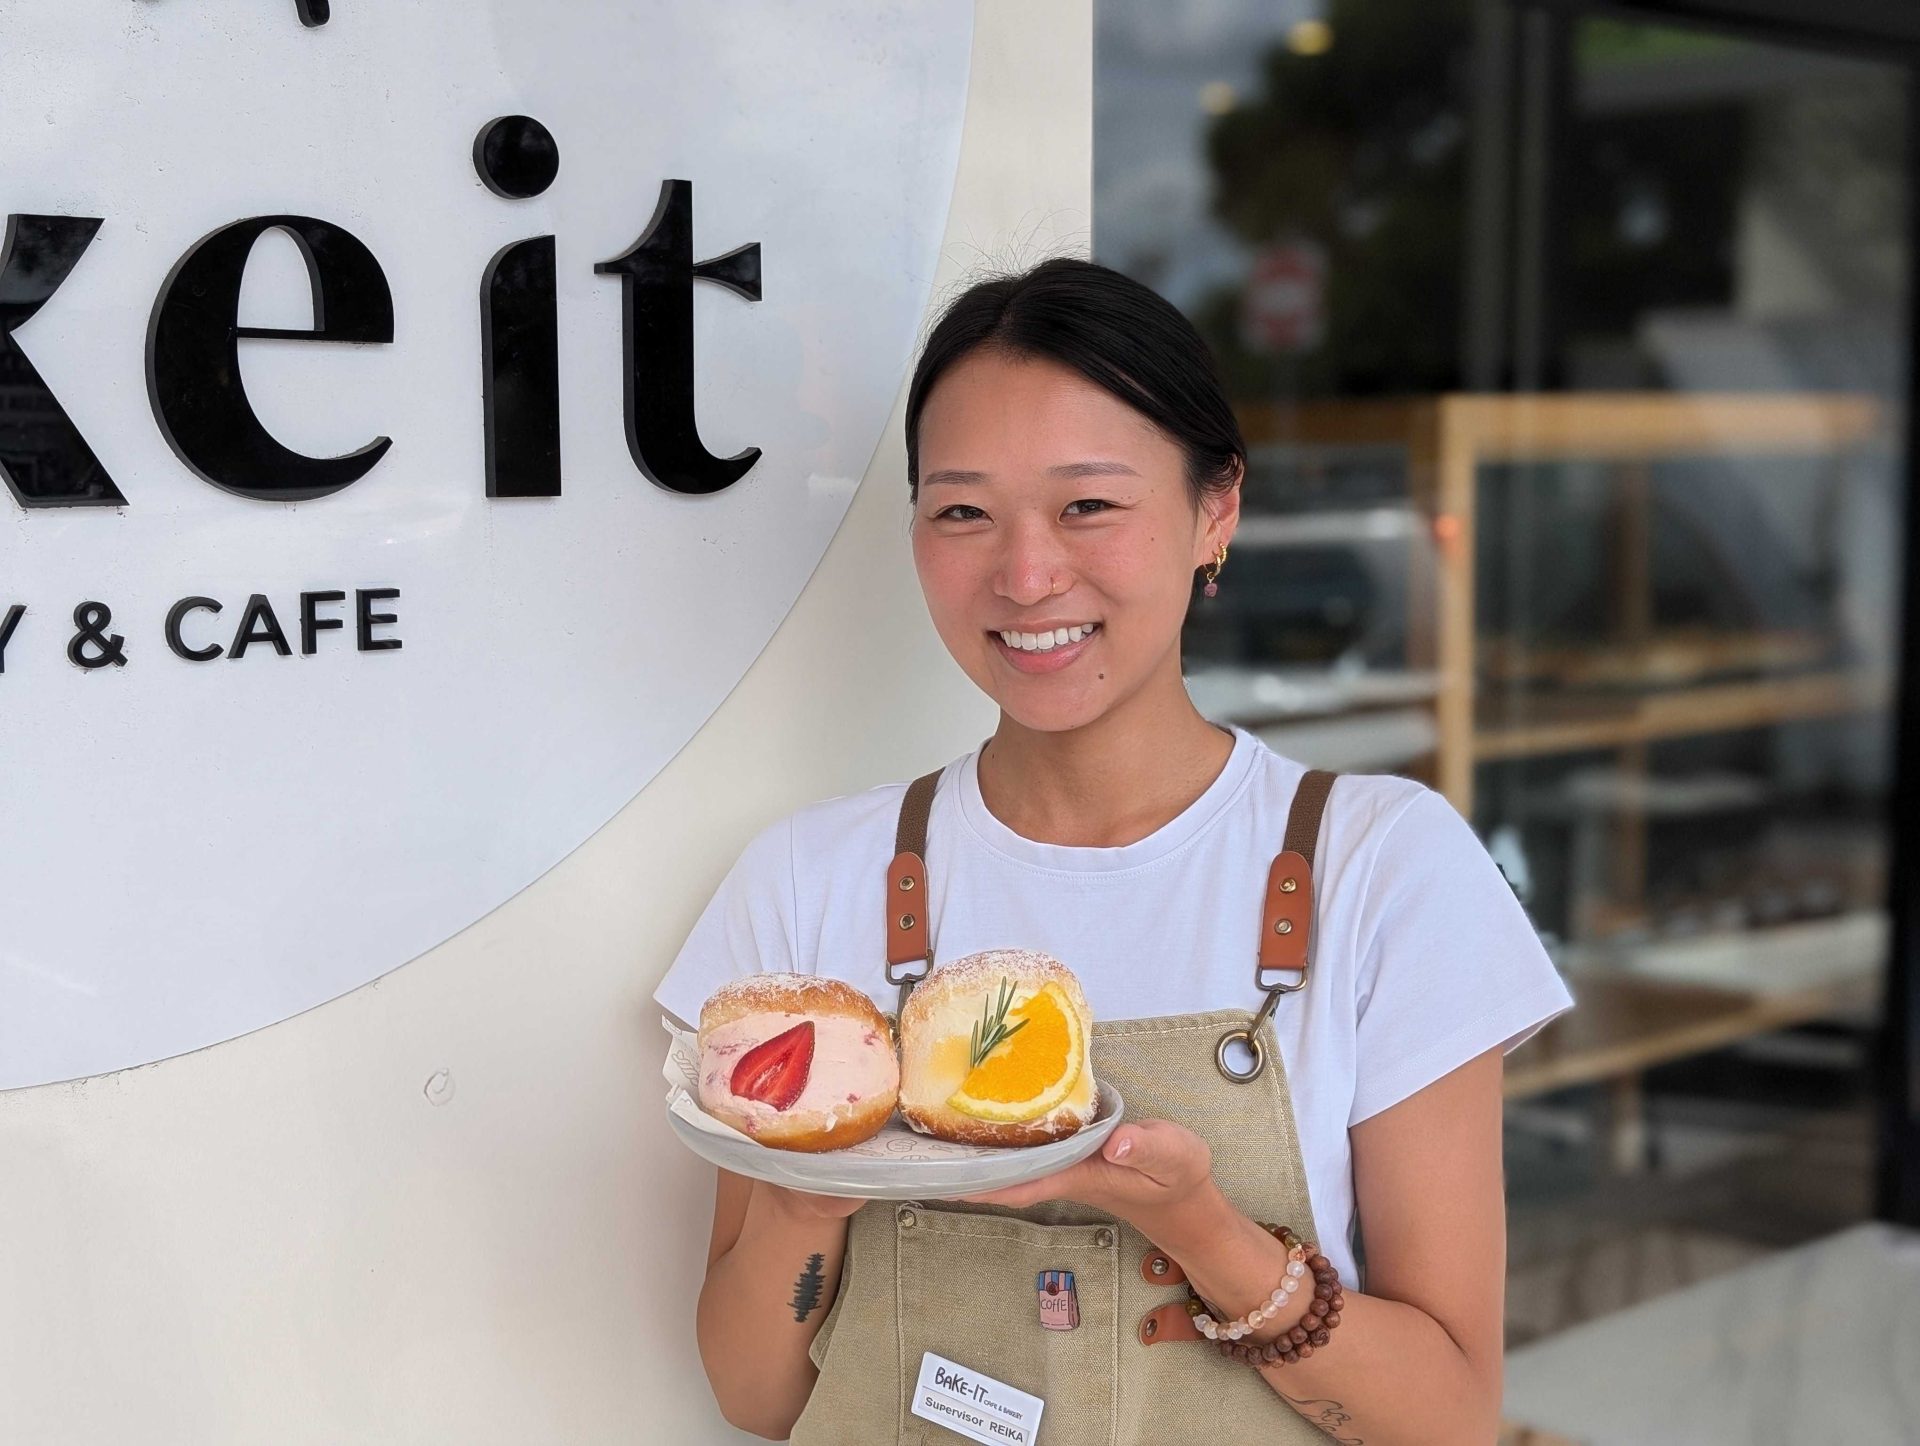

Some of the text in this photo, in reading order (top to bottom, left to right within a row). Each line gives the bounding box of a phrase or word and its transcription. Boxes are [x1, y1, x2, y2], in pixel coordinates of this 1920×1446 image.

[67, 601, 128, 668] &
[165, 588, 402, 661] CAFE
[925, 1396, 1024, 1443] Supervisor REIKA
